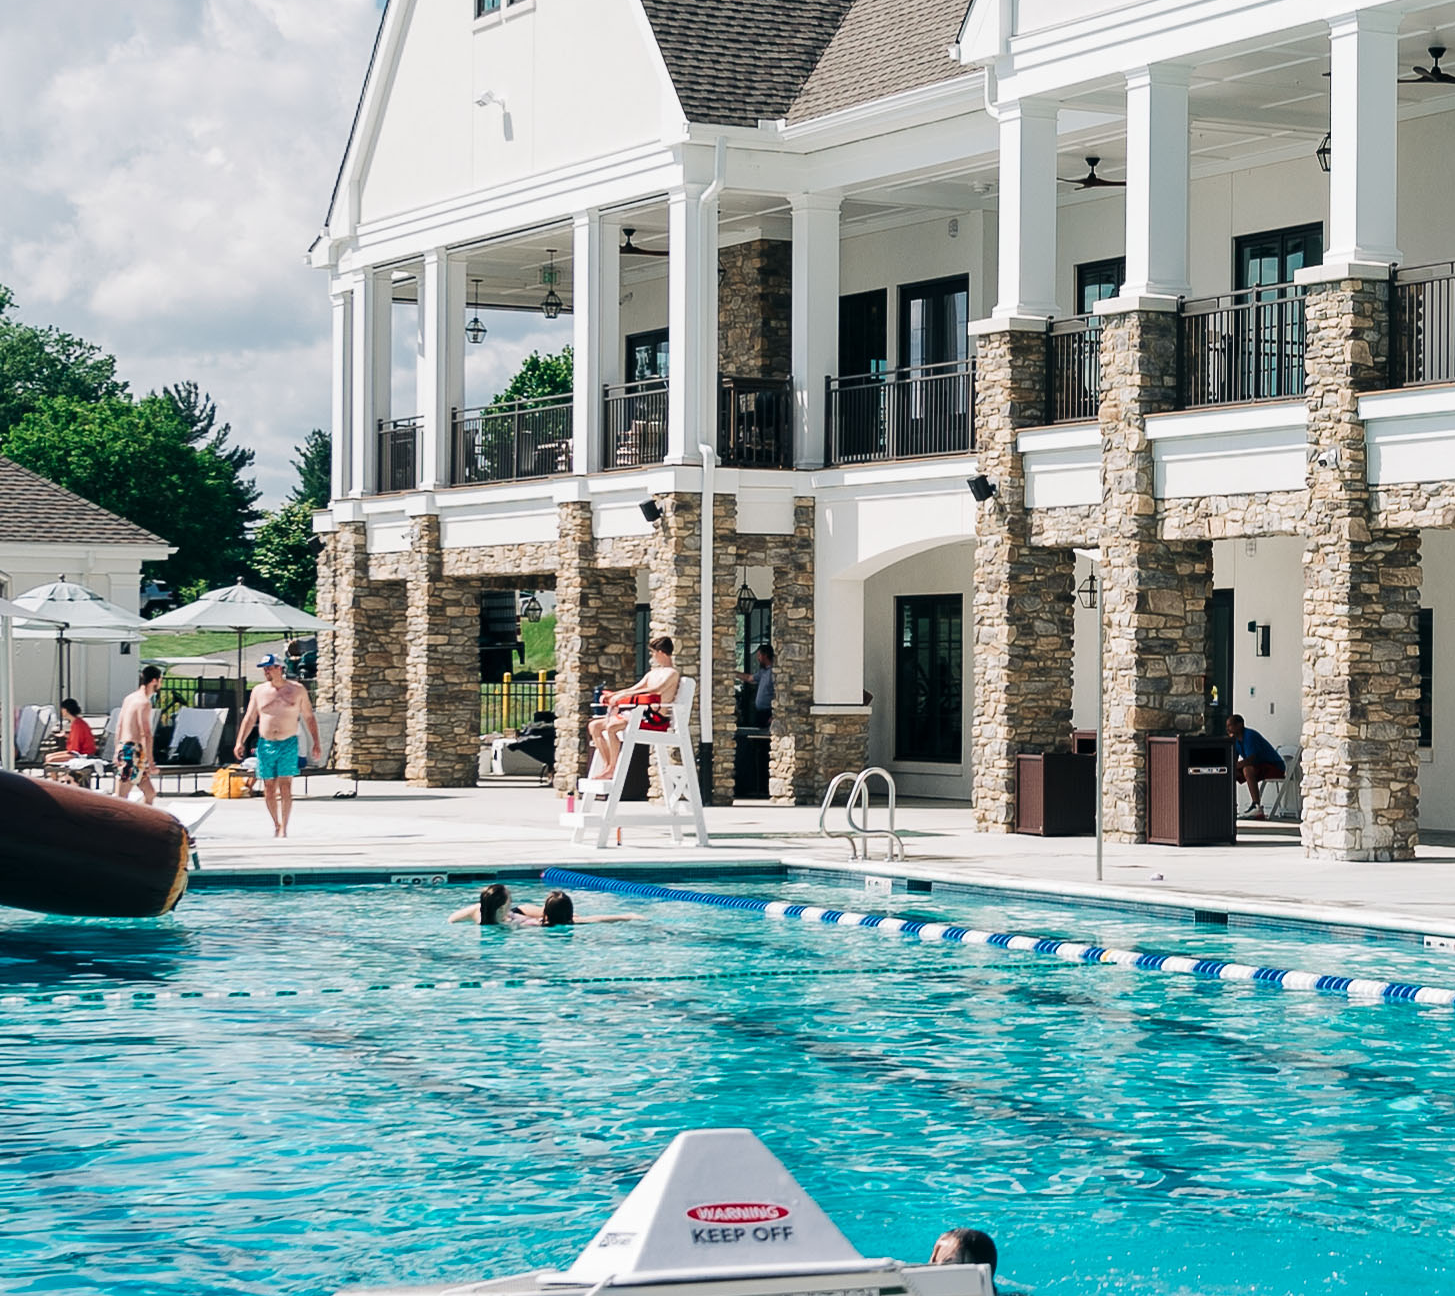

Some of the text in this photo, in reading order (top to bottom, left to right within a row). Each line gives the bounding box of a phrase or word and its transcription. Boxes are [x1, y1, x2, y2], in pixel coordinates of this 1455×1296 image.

[696, 1205, 781, 1221] WARNING
[692, 1225, 793, 1244] KEEP OFF
